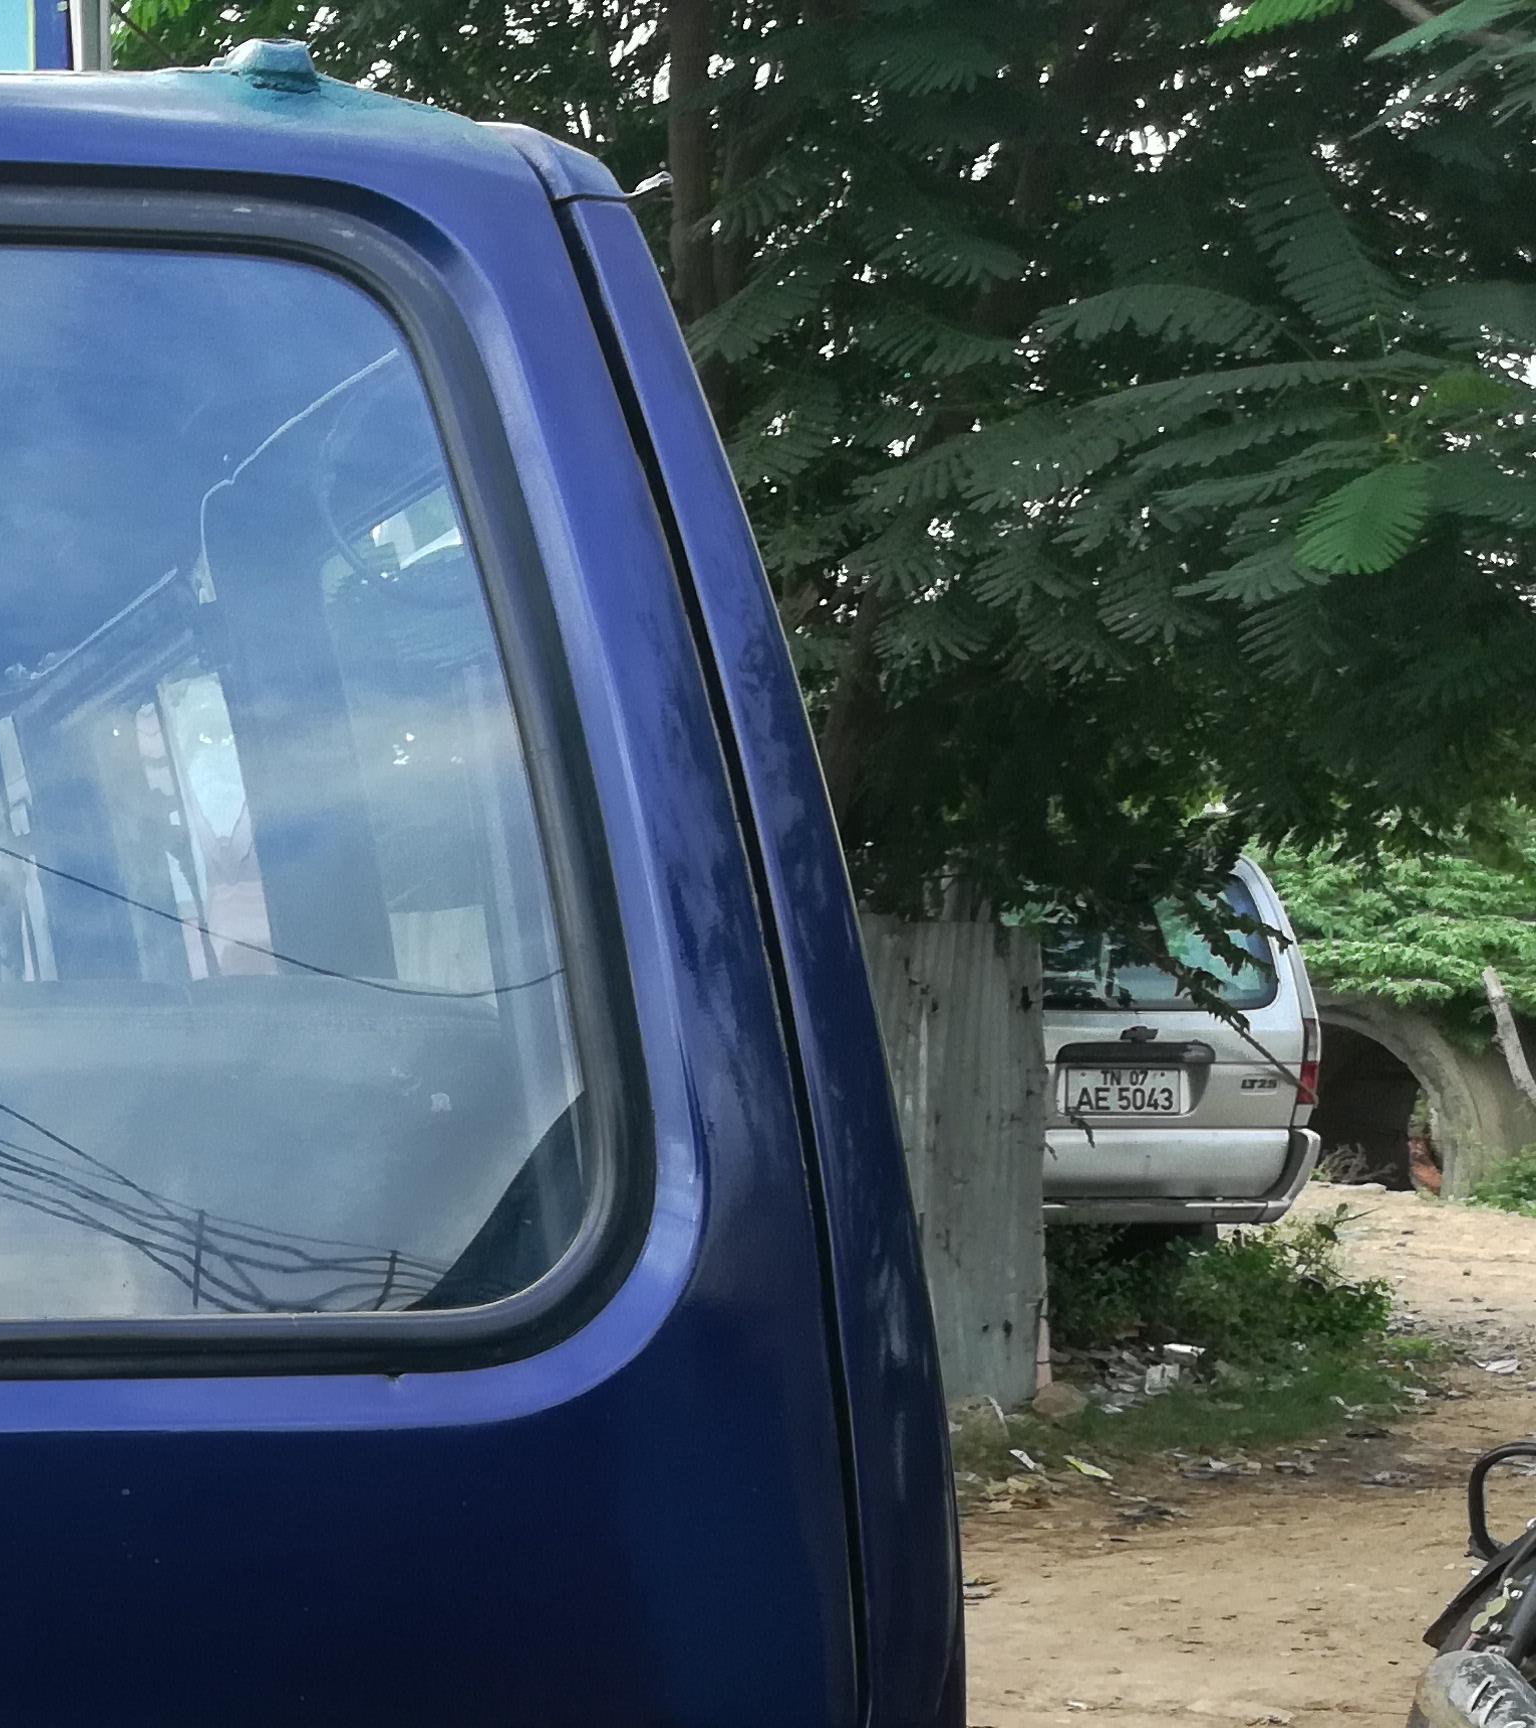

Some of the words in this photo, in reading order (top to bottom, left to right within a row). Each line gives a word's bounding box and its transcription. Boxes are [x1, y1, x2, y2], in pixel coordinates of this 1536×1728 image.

[1100, 1070, 1122, 1086] TN
[1129, 1070, 1148, 1087] 07
[1077, 1087, 1111, 1111] AE
[1117, 1087, 1174, 1111] 5043
